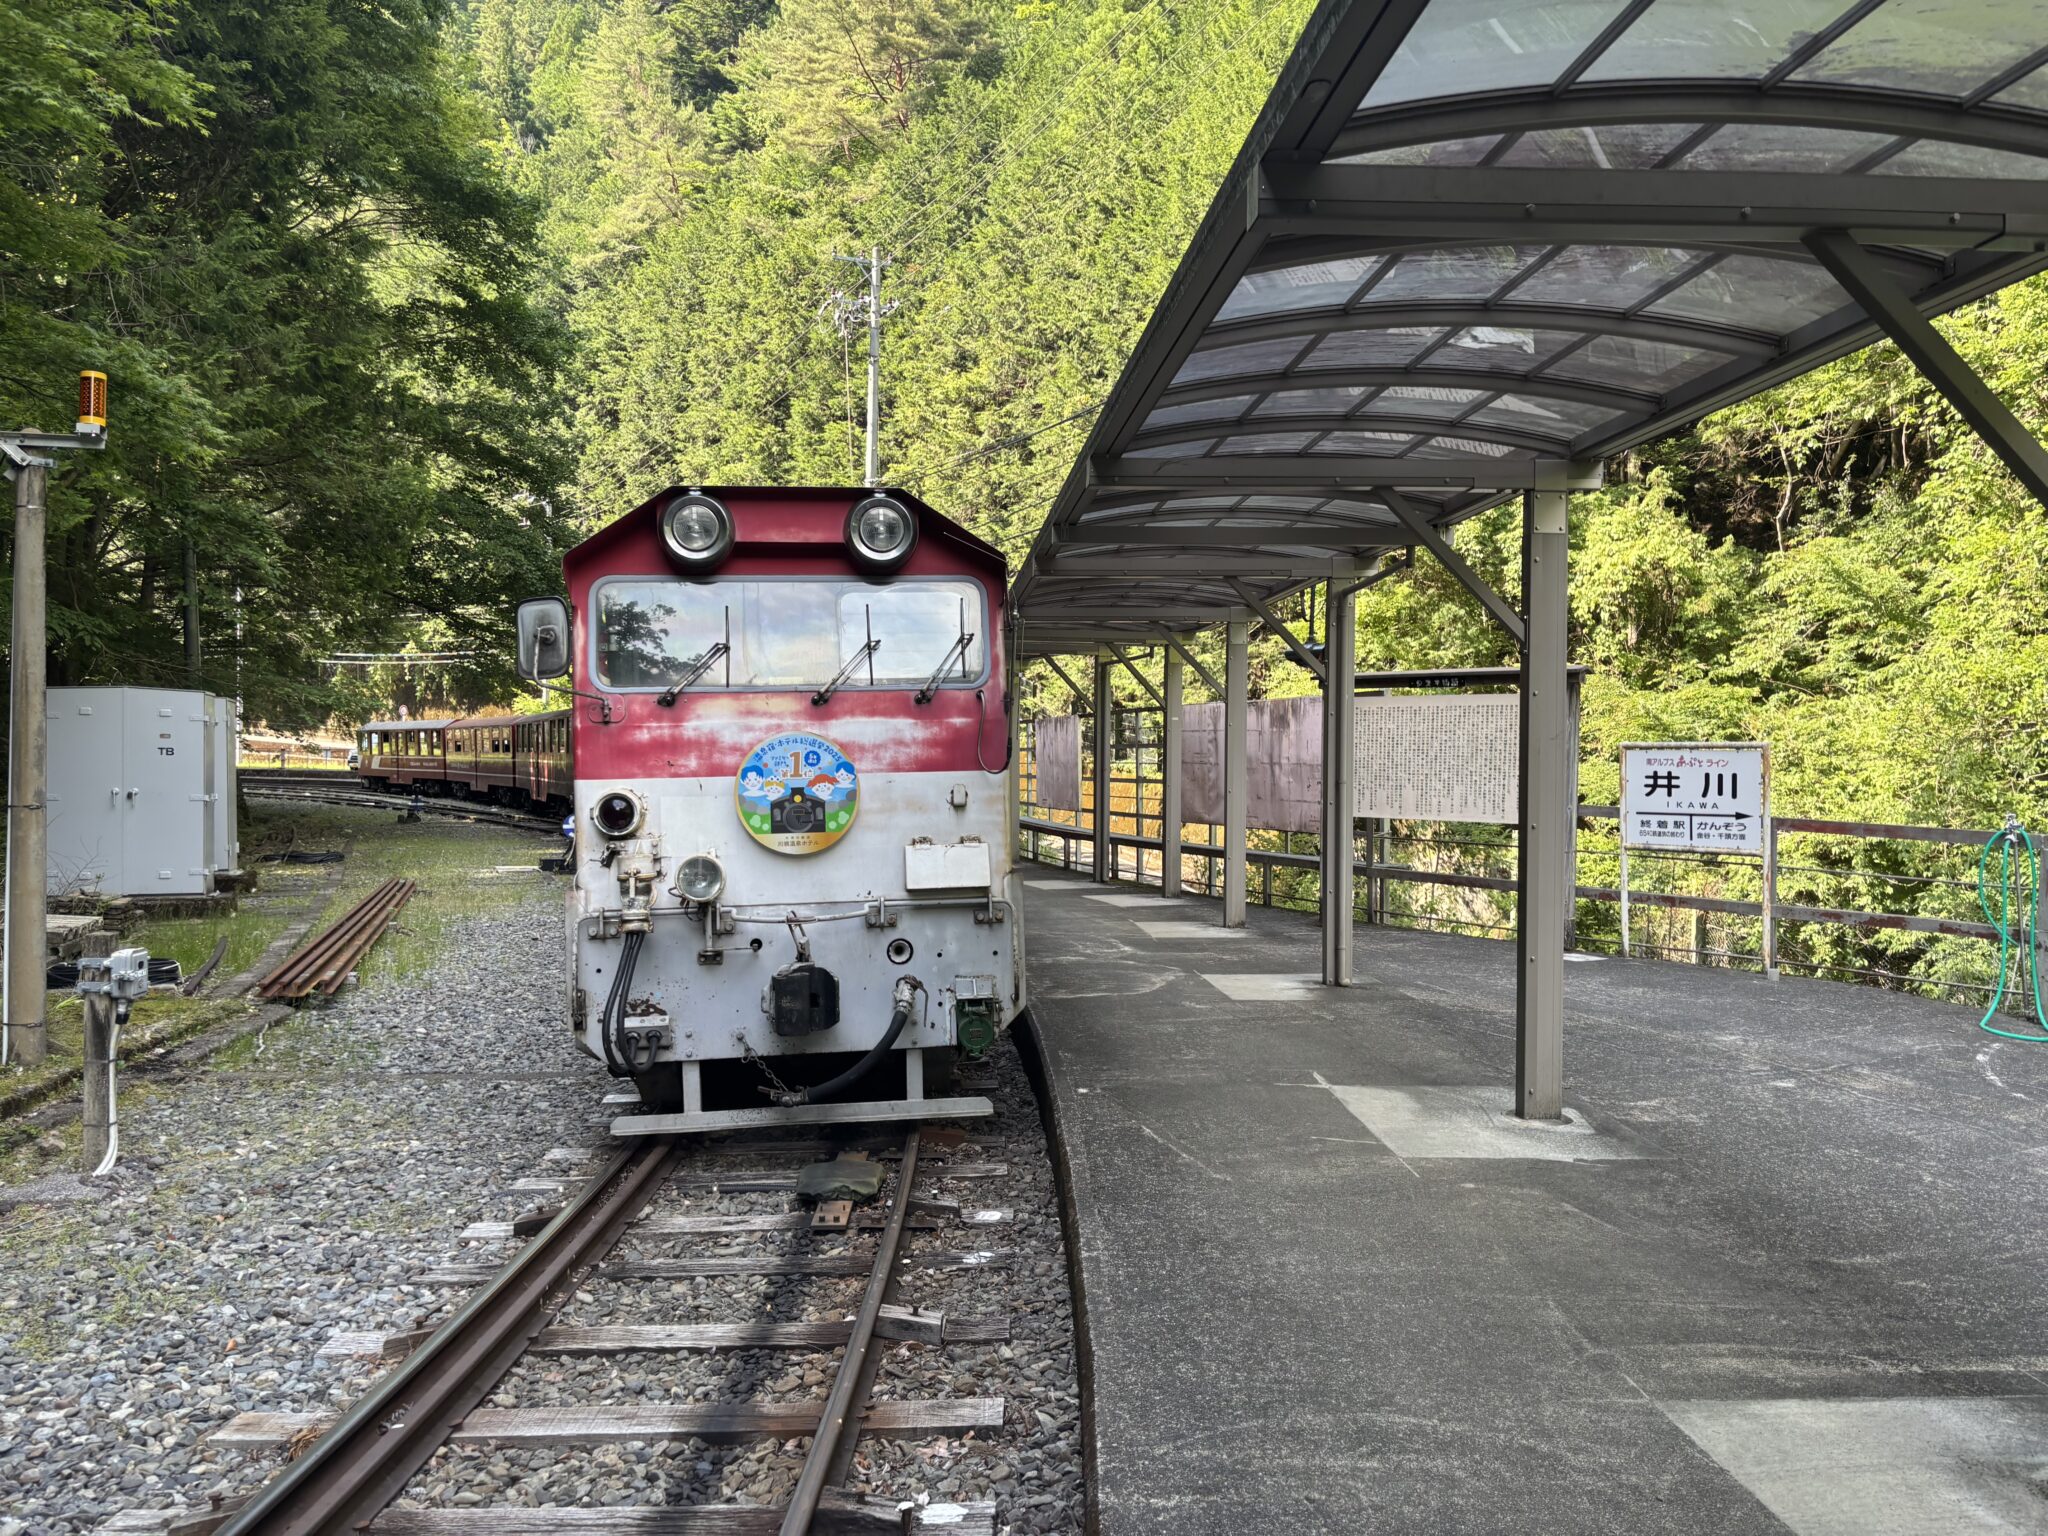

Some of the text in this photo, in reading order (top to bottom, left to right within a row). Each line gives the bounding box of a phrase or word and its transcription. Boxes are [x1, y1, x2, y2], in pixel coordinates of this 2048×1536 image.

[157, 747, 175, 756] TB
[1644, 770, 1738, 800] 井川
[1666, 801, 1719, 809] IKAWA
[1640, 819, 1686, 830] 終着駅
